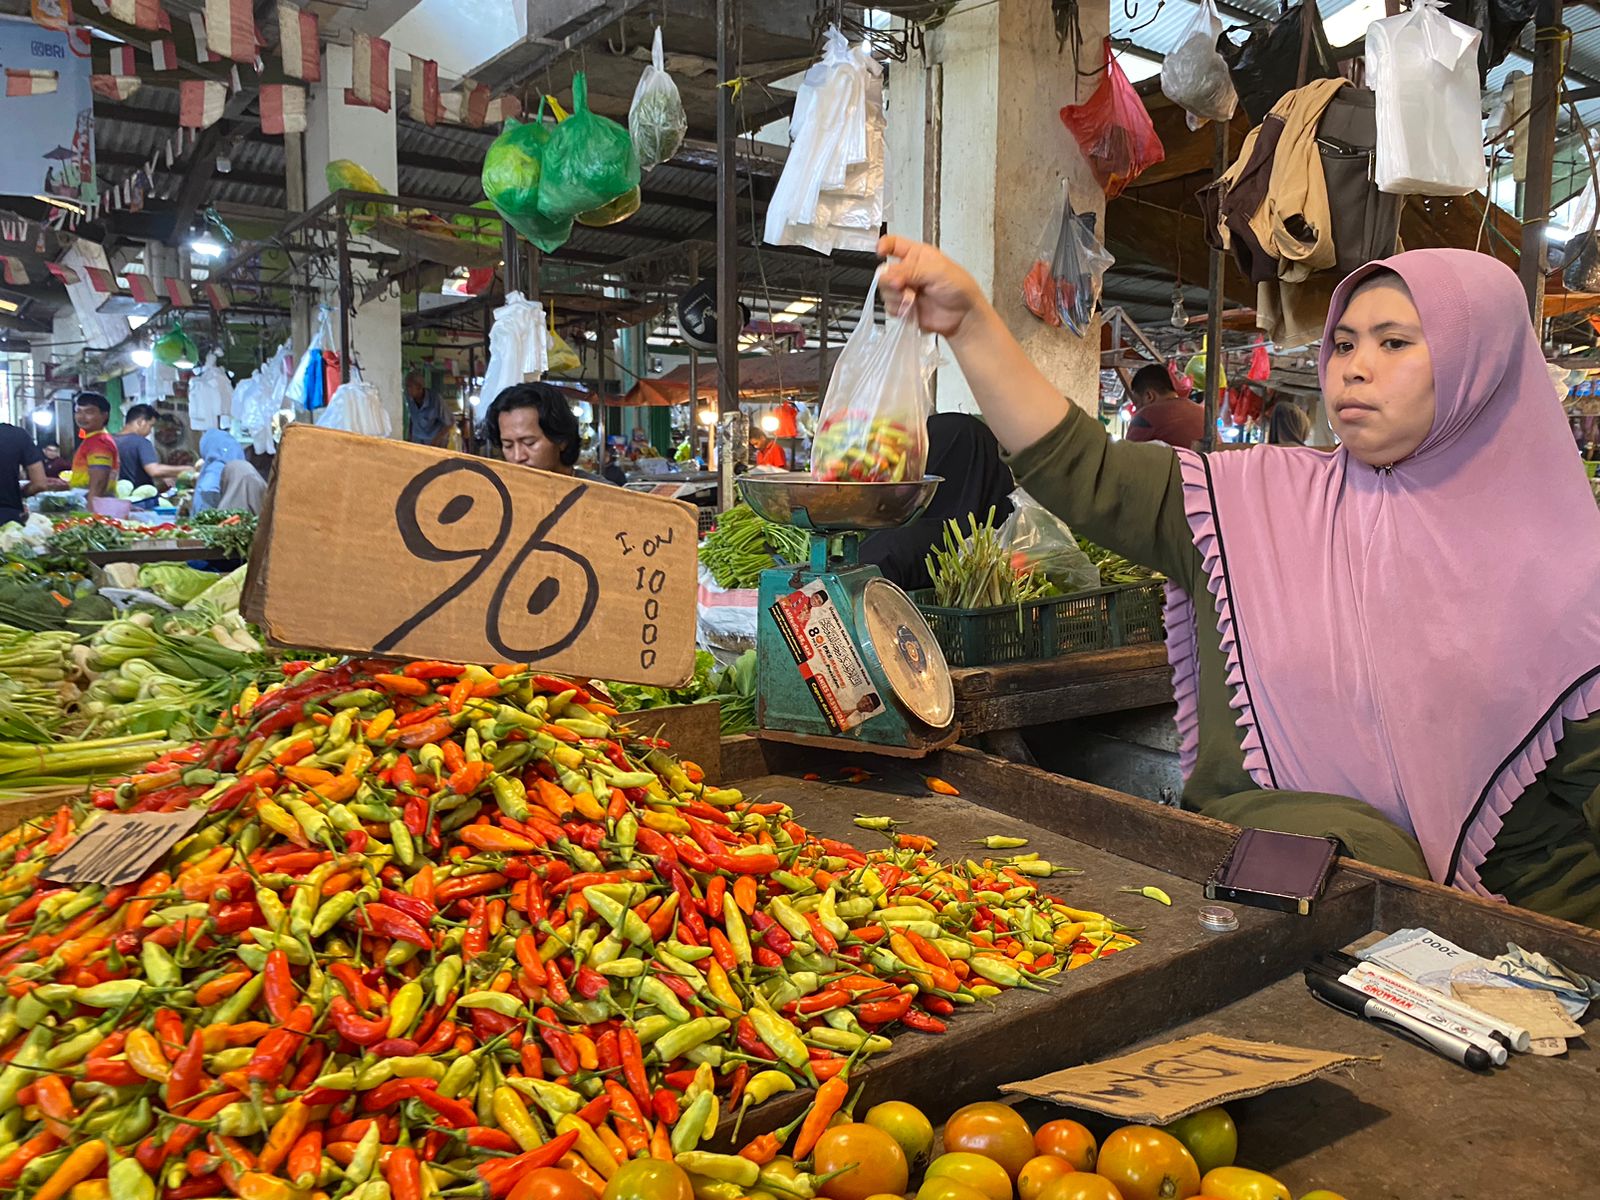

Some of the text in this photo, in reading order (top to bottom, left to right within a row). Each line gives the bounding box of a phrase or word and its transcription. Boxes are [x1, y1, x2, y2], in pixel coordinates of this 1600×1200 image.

[44, 44, 65, 58] BRI
[807, 626, 820, 637] 8
[1422, 937, 1459, 957] 2000
[1363, 984, 1413, 1009] SNOWMAN
